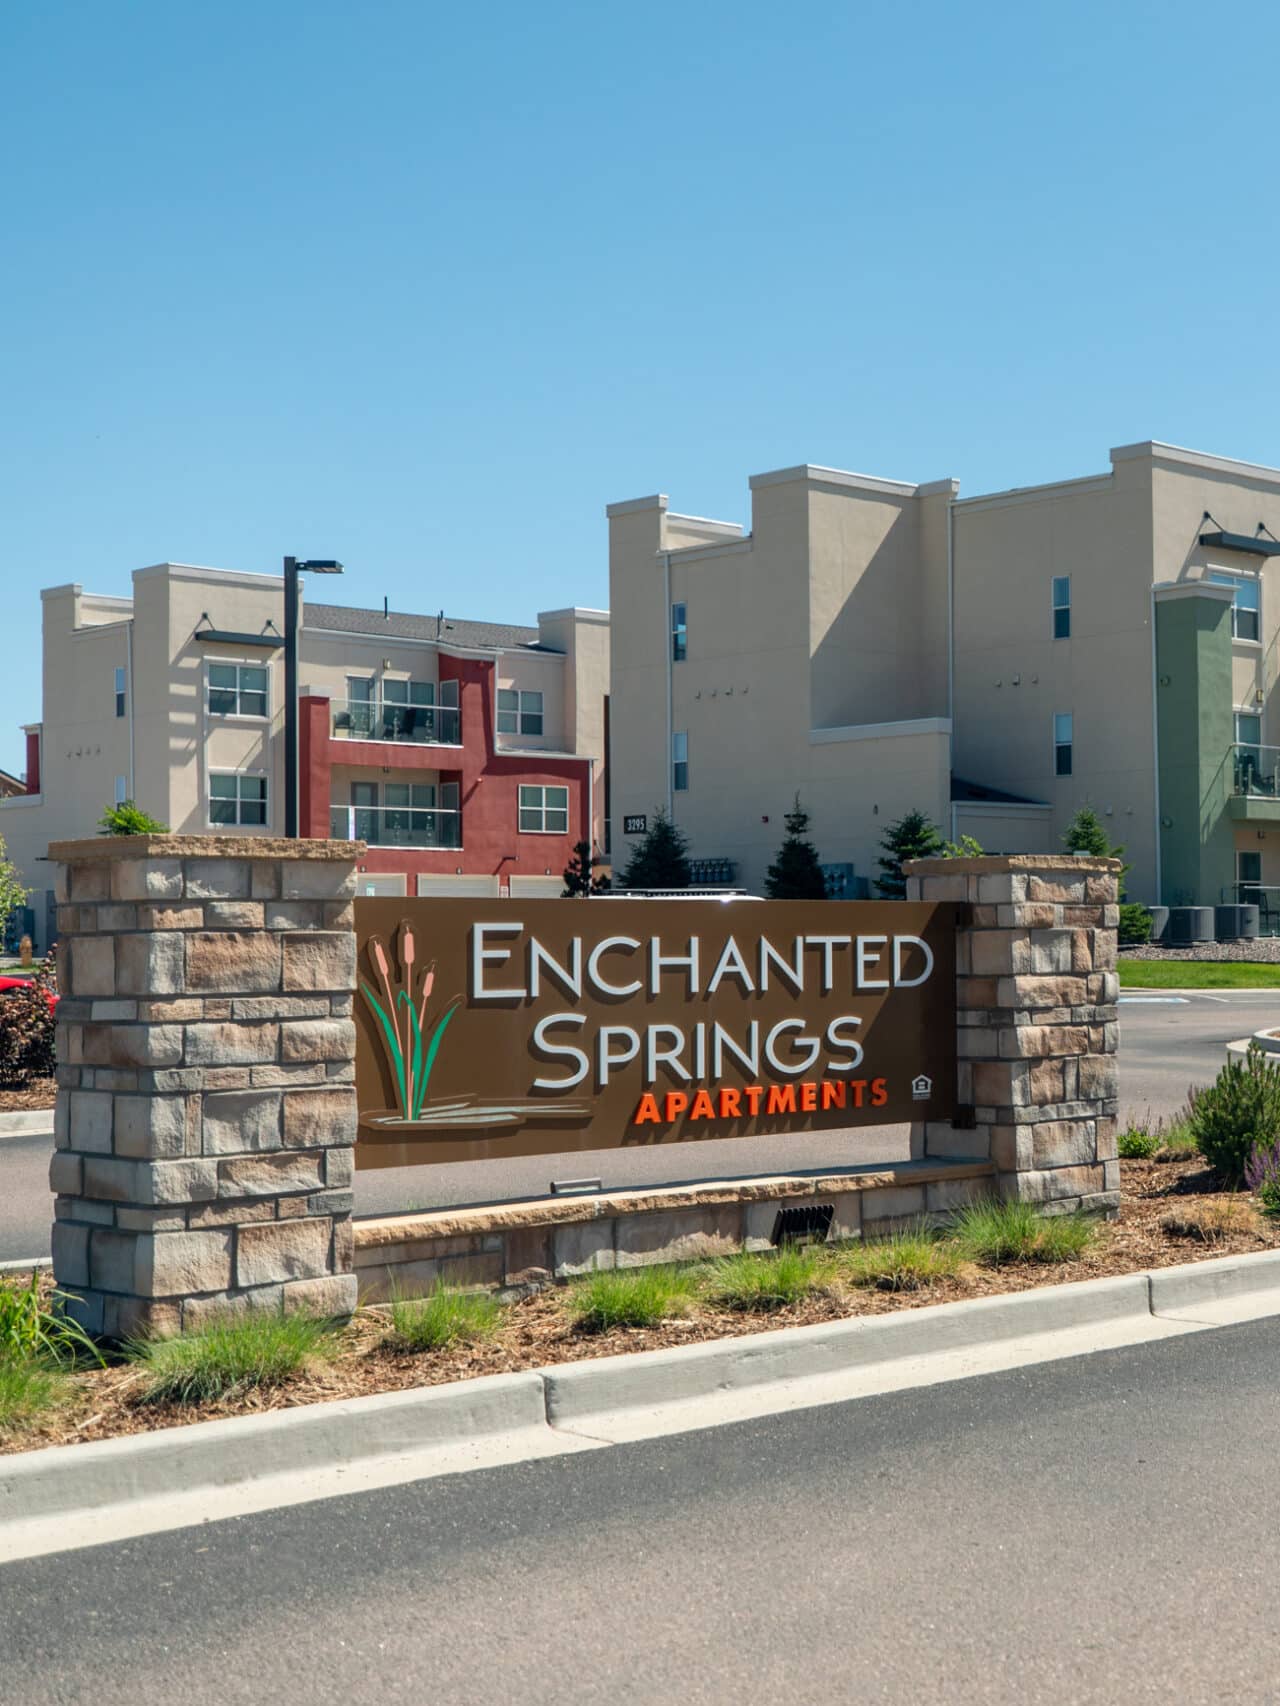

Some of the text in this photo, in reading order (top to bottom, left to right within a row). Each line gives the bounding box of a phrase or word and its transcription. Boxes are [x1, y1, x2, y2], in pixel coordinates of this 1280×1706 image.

[627, 818, 645, 831] 3295
[472, 922, 935, 1000] ENCHANTED
[533, 1012, 865, 1090] SPRINGS
[634, 1078, 889, 1125] APARTMENTS
